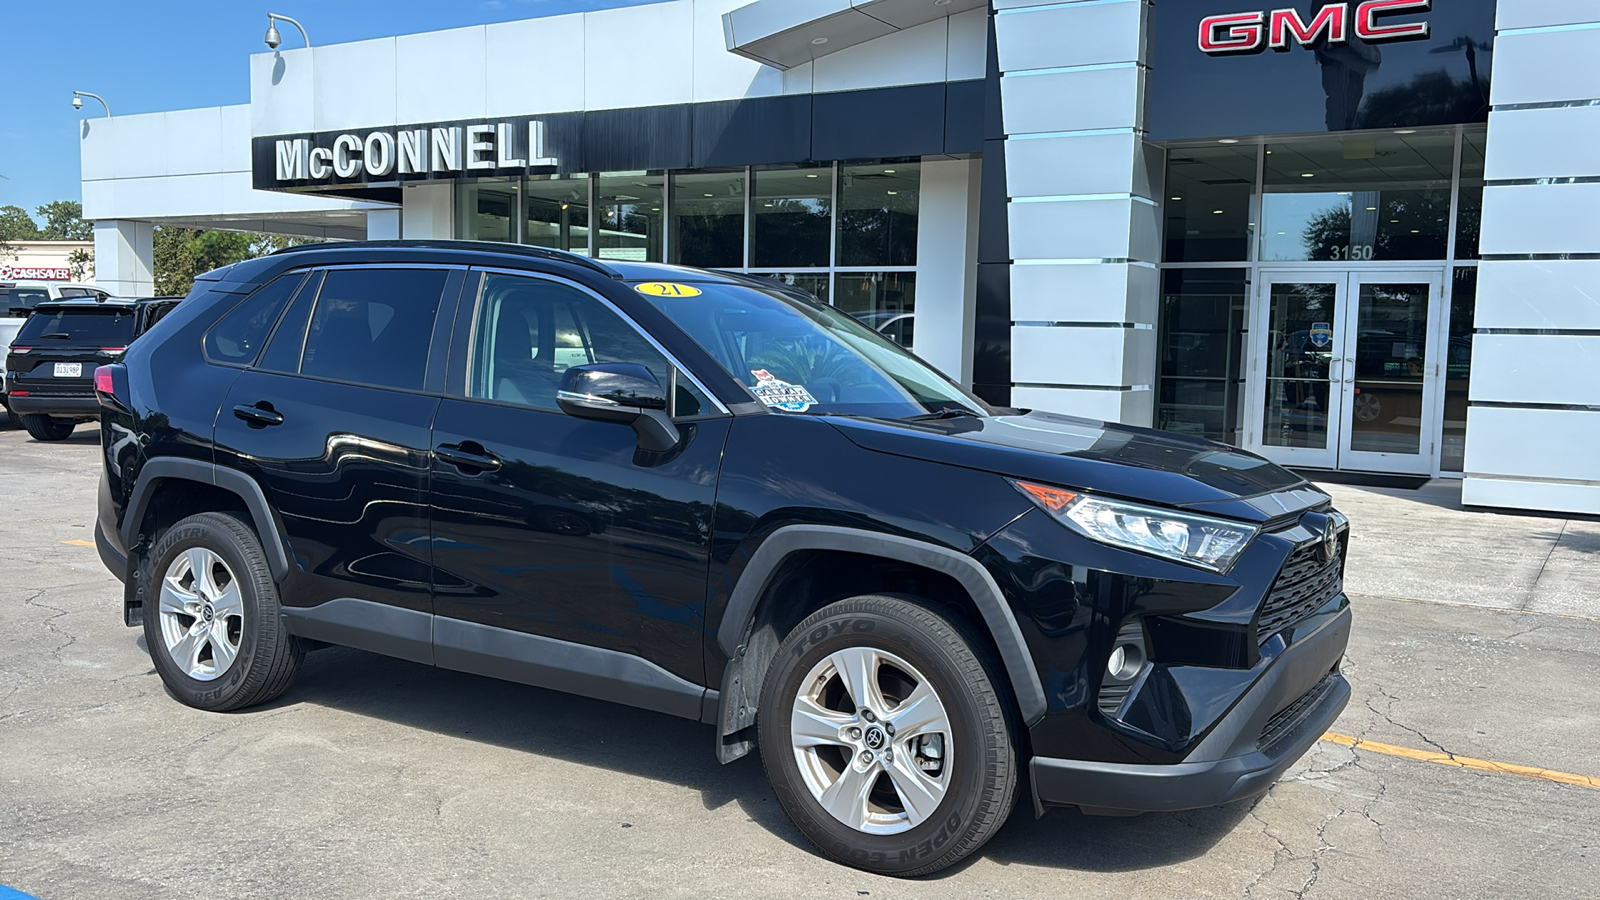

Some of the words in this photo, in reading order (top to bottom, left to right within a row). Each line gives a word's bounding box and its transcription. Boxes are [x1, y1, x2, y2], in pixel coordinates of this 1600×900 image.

[1198, 0, 1431, 53] GMC
[1330, 245, 1373, 260] 3150
[653, 283, 685, 296] 21
[791, 618, 876, 660] TOYO
